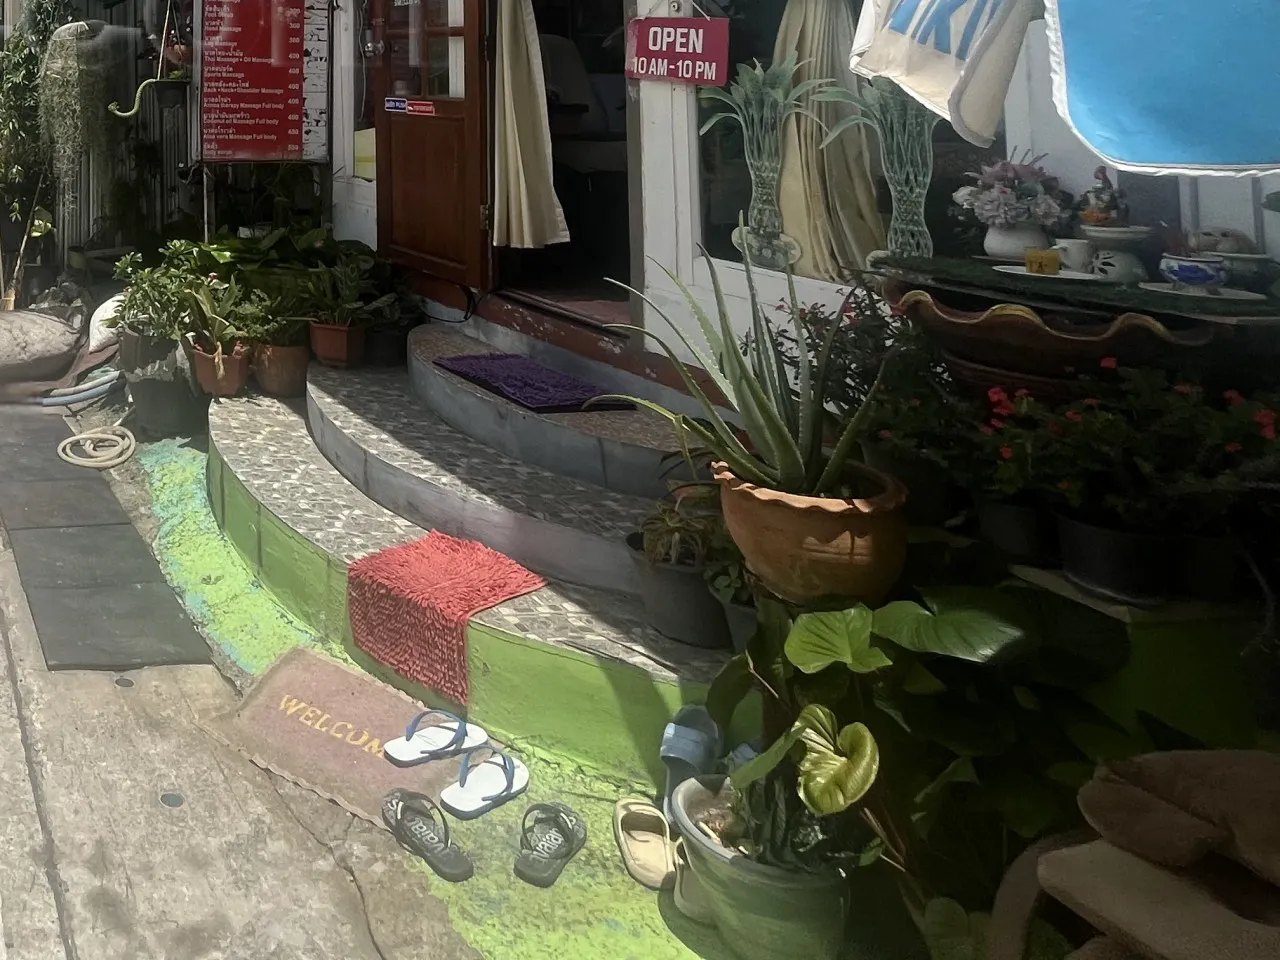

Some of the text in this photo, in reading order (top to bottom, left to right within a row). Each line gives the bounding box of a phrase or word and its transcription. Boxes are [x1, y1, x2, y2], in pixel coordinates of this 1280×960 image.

[648, 26, 703, 54] OPEN
[695, 61, 717, 80] PM
[279, 694, 385, 758] WELCOM
